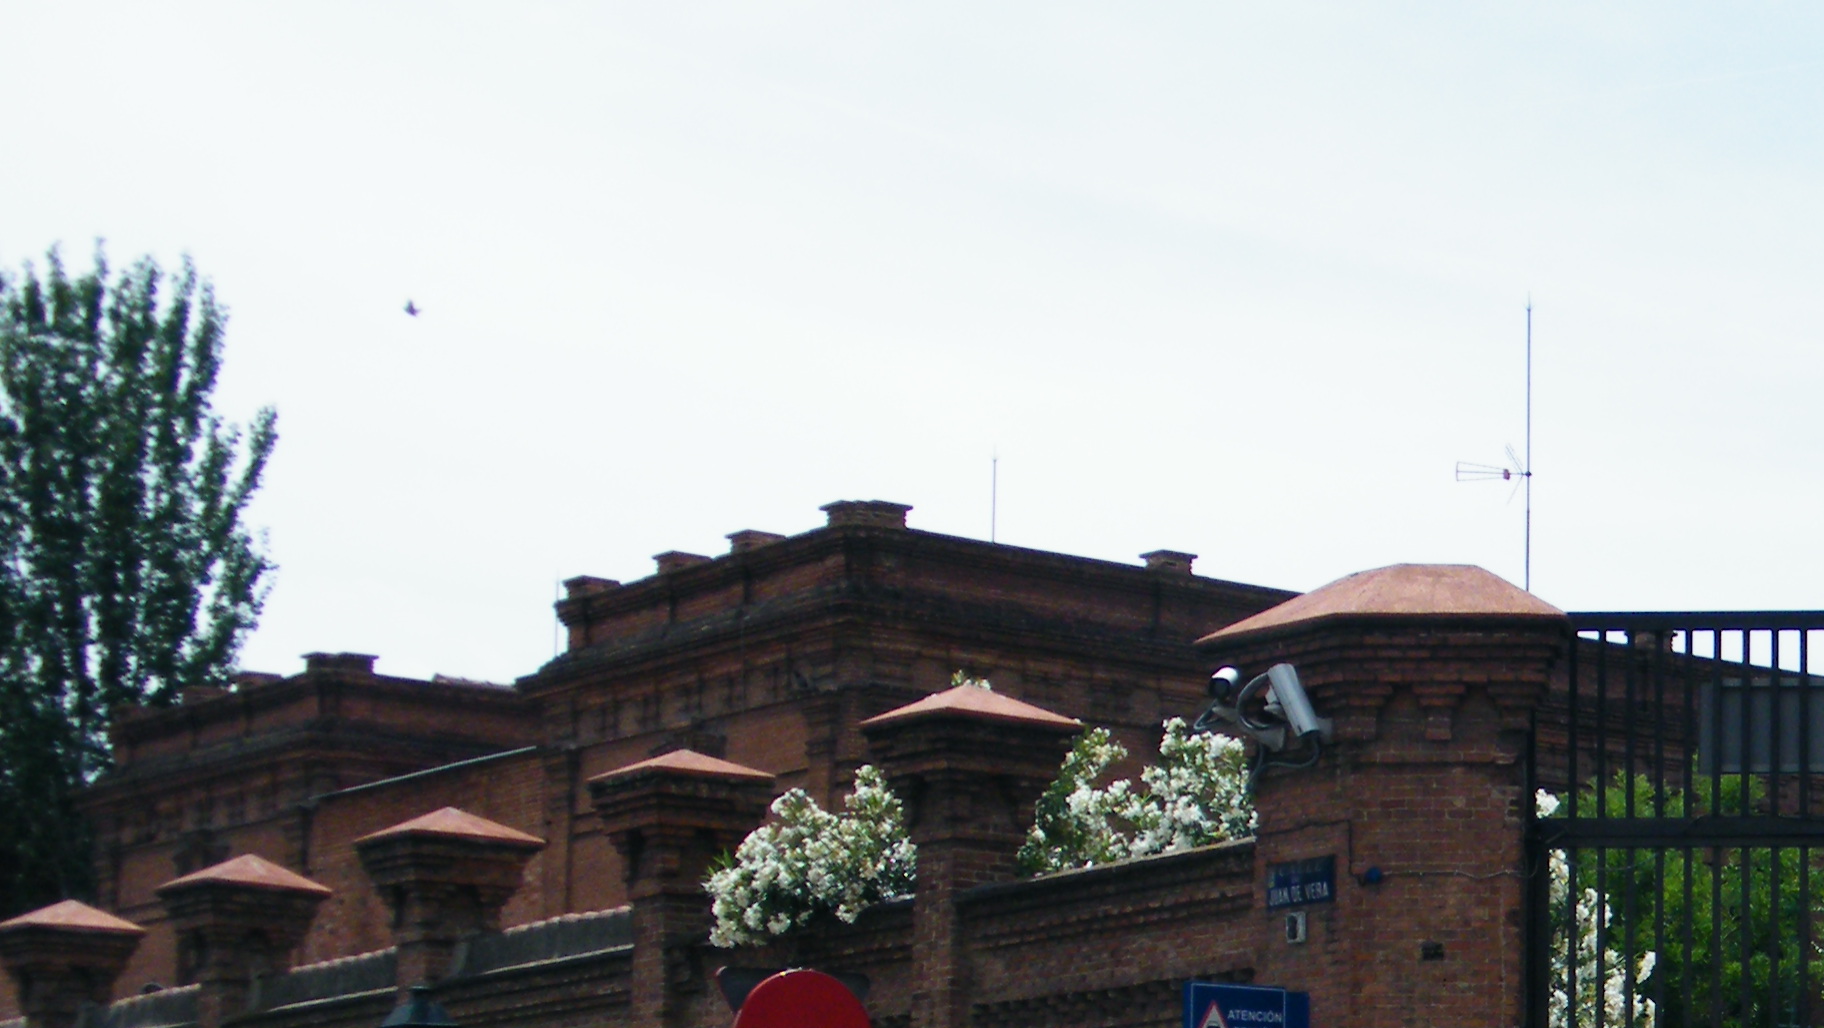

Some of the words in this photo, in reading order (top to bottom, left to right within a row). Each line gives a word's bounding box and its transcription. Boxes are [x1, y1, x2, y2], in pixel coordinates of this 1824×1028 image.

[1269, 886, 1291, 907] JUAN
[1291, 885, 1303, 903] DE
[1304, 881, 1330, 900] VERA
[1227, 1009, 1283, 1023] ATENCIÓN
